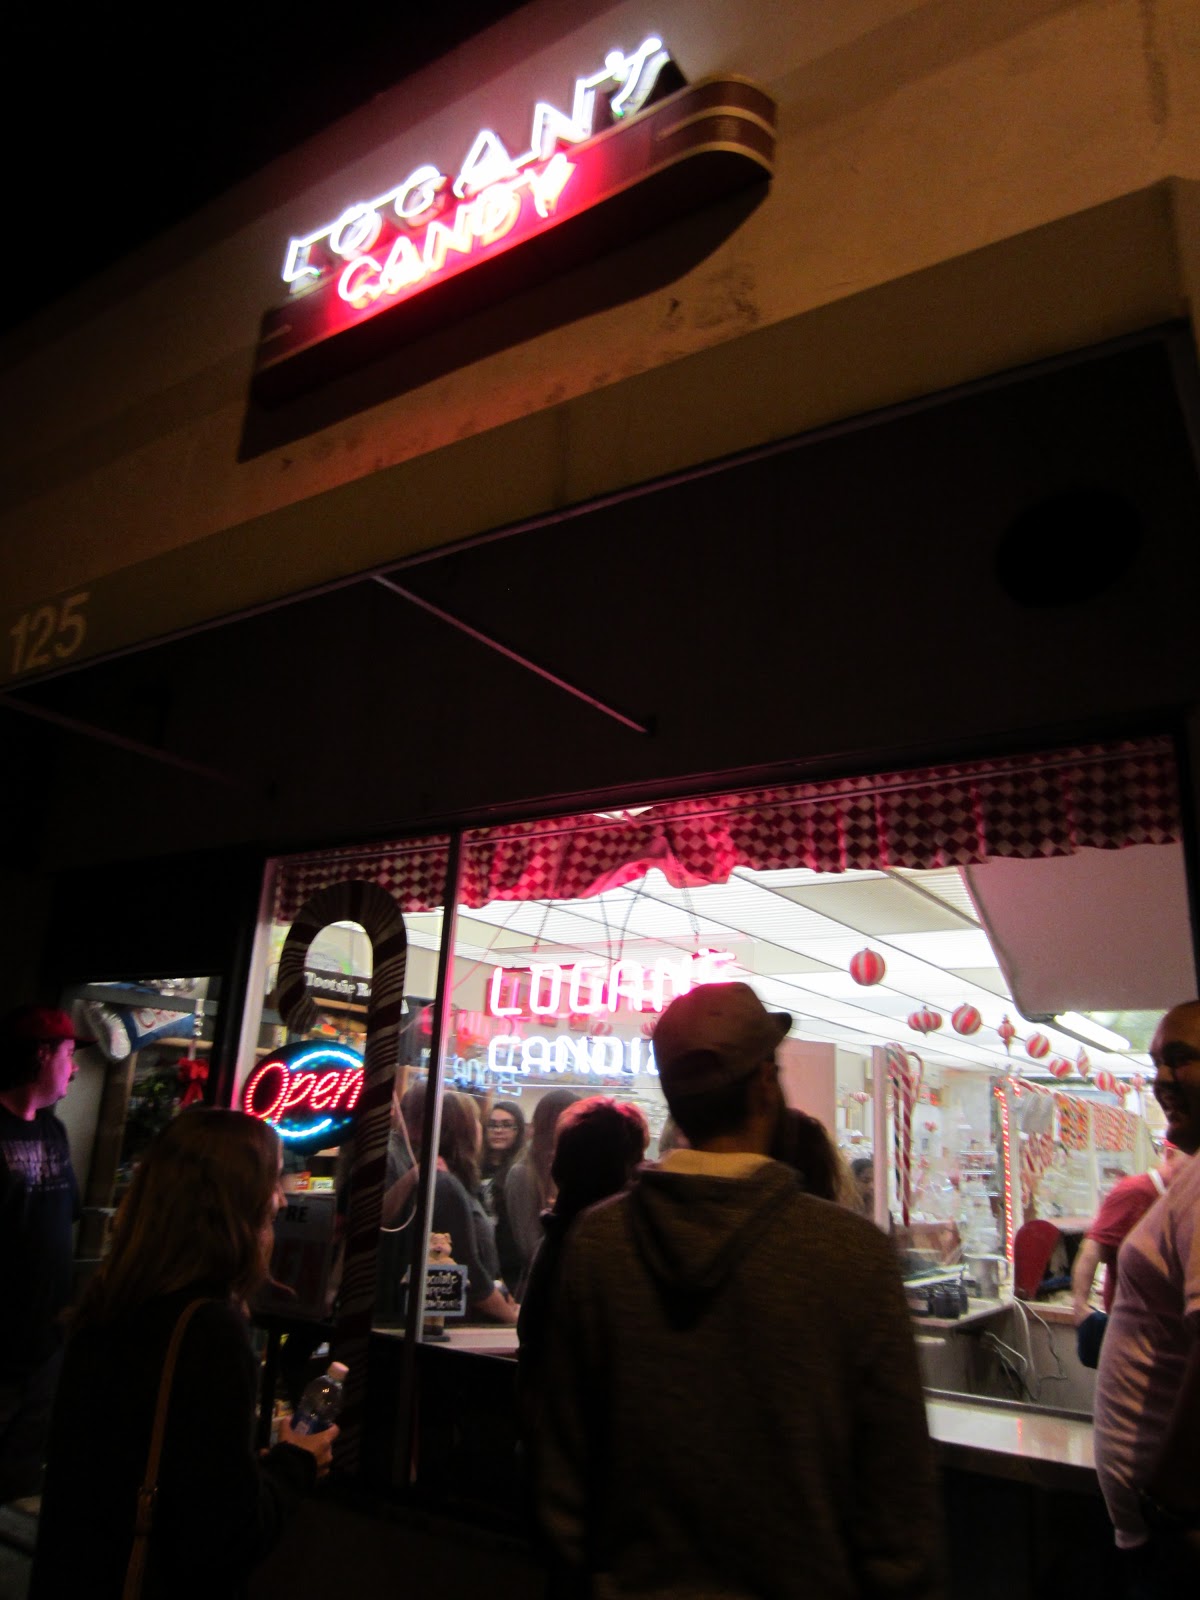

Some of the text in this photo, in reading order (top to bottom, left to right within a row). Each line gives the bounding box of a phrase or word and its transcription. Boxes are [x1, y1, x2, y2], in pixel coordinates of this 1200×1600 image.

[337, 154, 577, 308] CANDY
[10, 591, 90, 674] 125
[304, 971, 356, 994] Tootsie
[244, 1061, 365, 1125] Open
